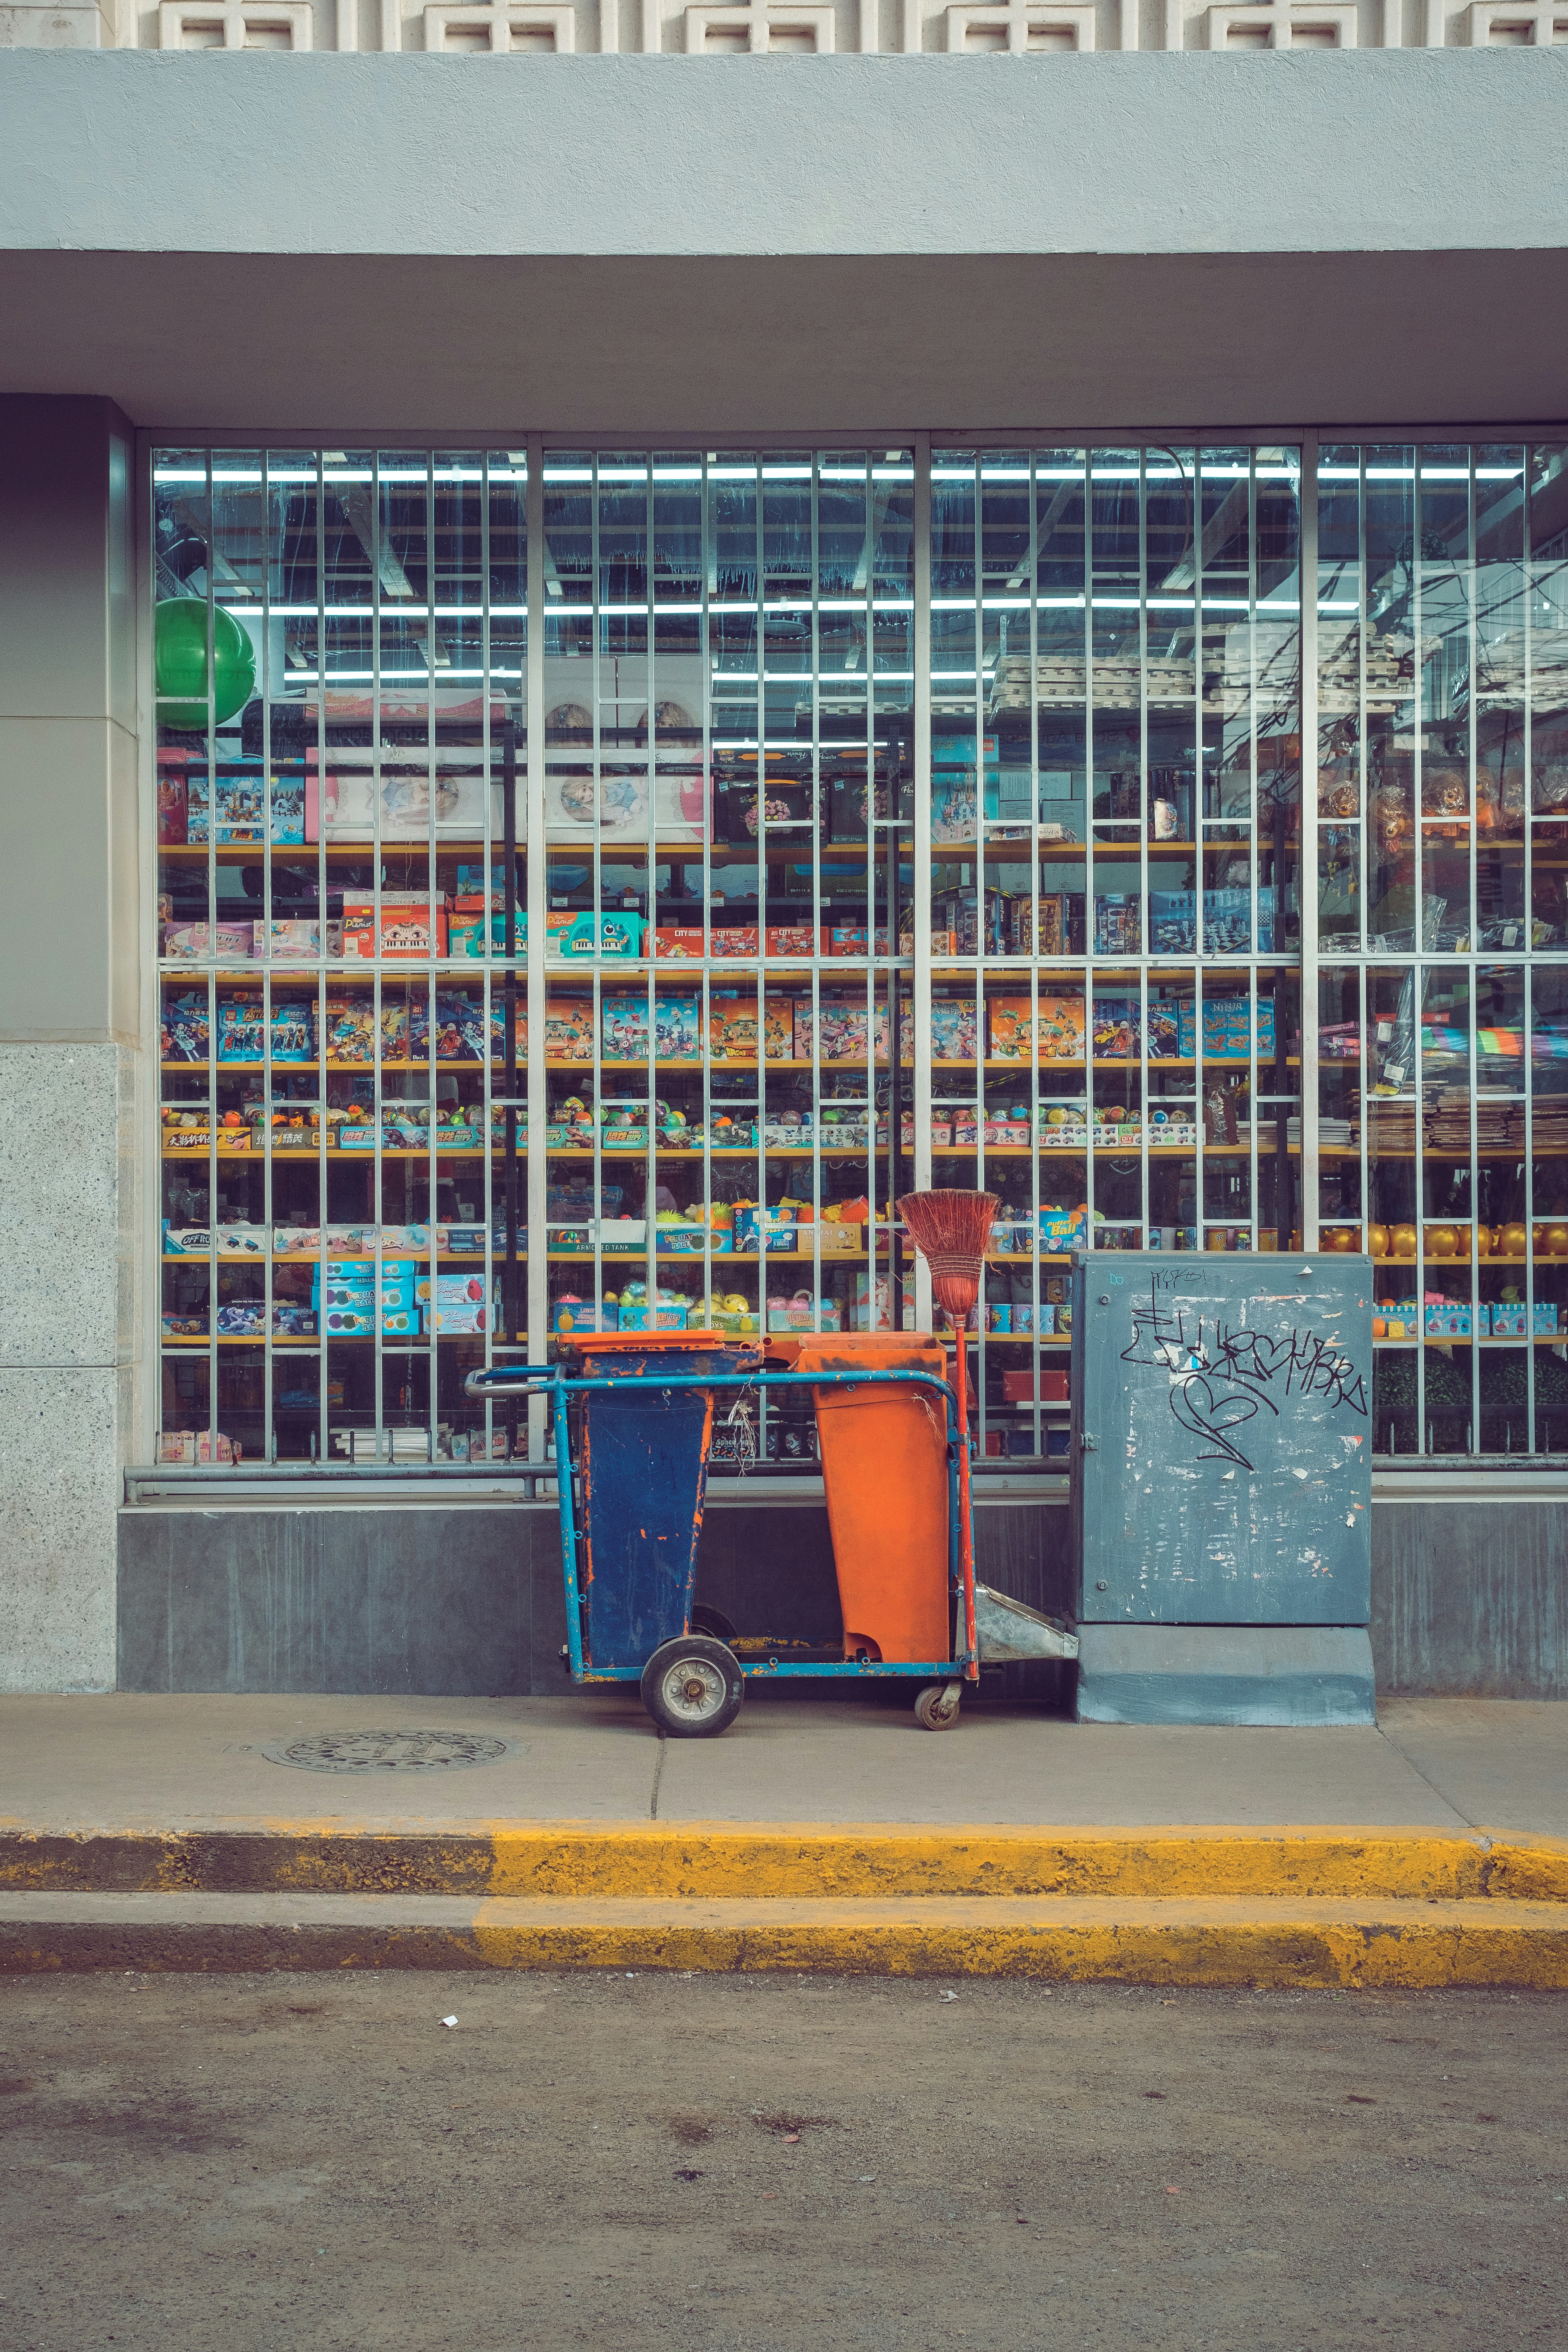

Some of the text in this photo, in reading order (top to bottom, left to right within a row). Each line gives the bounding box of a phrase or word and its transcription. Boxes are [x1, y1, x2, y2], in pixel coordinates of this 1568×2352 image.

[345, 919, 373, 929] Pianist
[452, 916, 479, 926] Pianist
[547, 916, 574, 925] Pianist
[1212, 1003, 1243, 1013] NINJA
[726, 1047, 746, 1057] DRAGON
[1051, 1223, 1077, 1236] Ball
[183, 1234, 210, 1245] OFF RO
[672, 1241, 689, 1250] BALL
[347, 1290, 376, 1301] FERHA
[354, 1314, 388, 1325] FERHT
